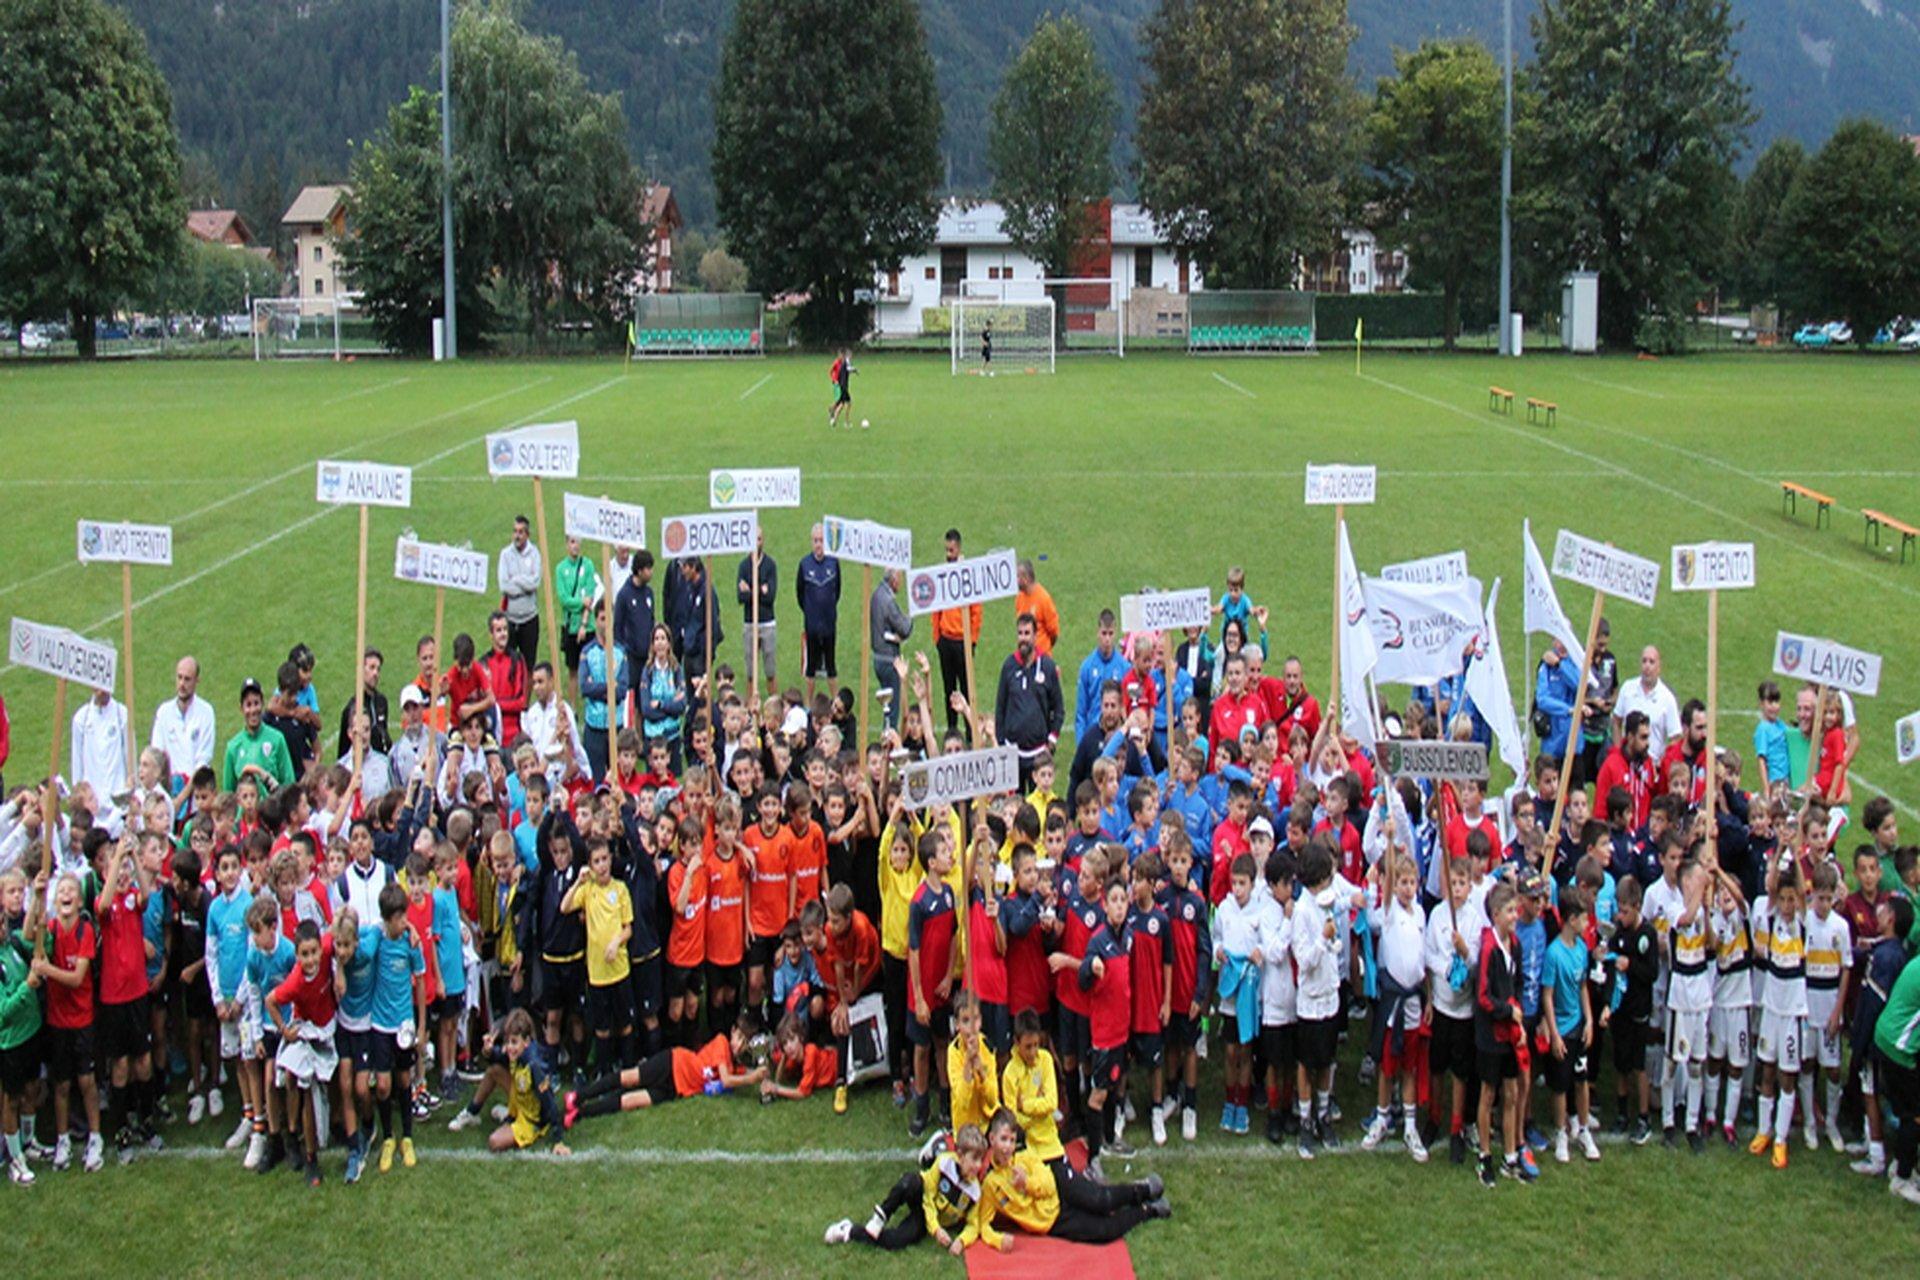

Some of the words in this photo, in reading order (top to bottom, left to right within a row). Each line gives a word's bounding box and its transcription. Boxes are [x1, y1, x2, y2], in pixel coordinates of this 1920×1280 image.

[518, 442, 572, 472] SOLTERI
[347, 470, 403, 501] ANAUNE
[599, 508, 643, 542] PREDAIA
[689, 520, 751, 550] BOZNER
[105, 528, 127, 554] VIPO
[129, 530, 167, 558] TRENTO
[844, 527, 864, 557] ALTA
[423, 553, 469, 586] LEVICO
[473, 562, 484, 587] T.
[937, 561, 1011, 600] TOBLINO
[1577, 547, 1655, 601] SETTAURENSE
[1703, 551, 1749, 581] TRENTO
[1146, 597, 1208, 627] SOPRAMONTE
[37, 636, 112, 687] VALDICEMBRA
[1810, 648, 1866, 686] LAVIS
[934, 759, 994, 796] COMANO
[998, 756, 1012, 786] T.
[1402, 747, 1482, 774] BUSSOLENGO
